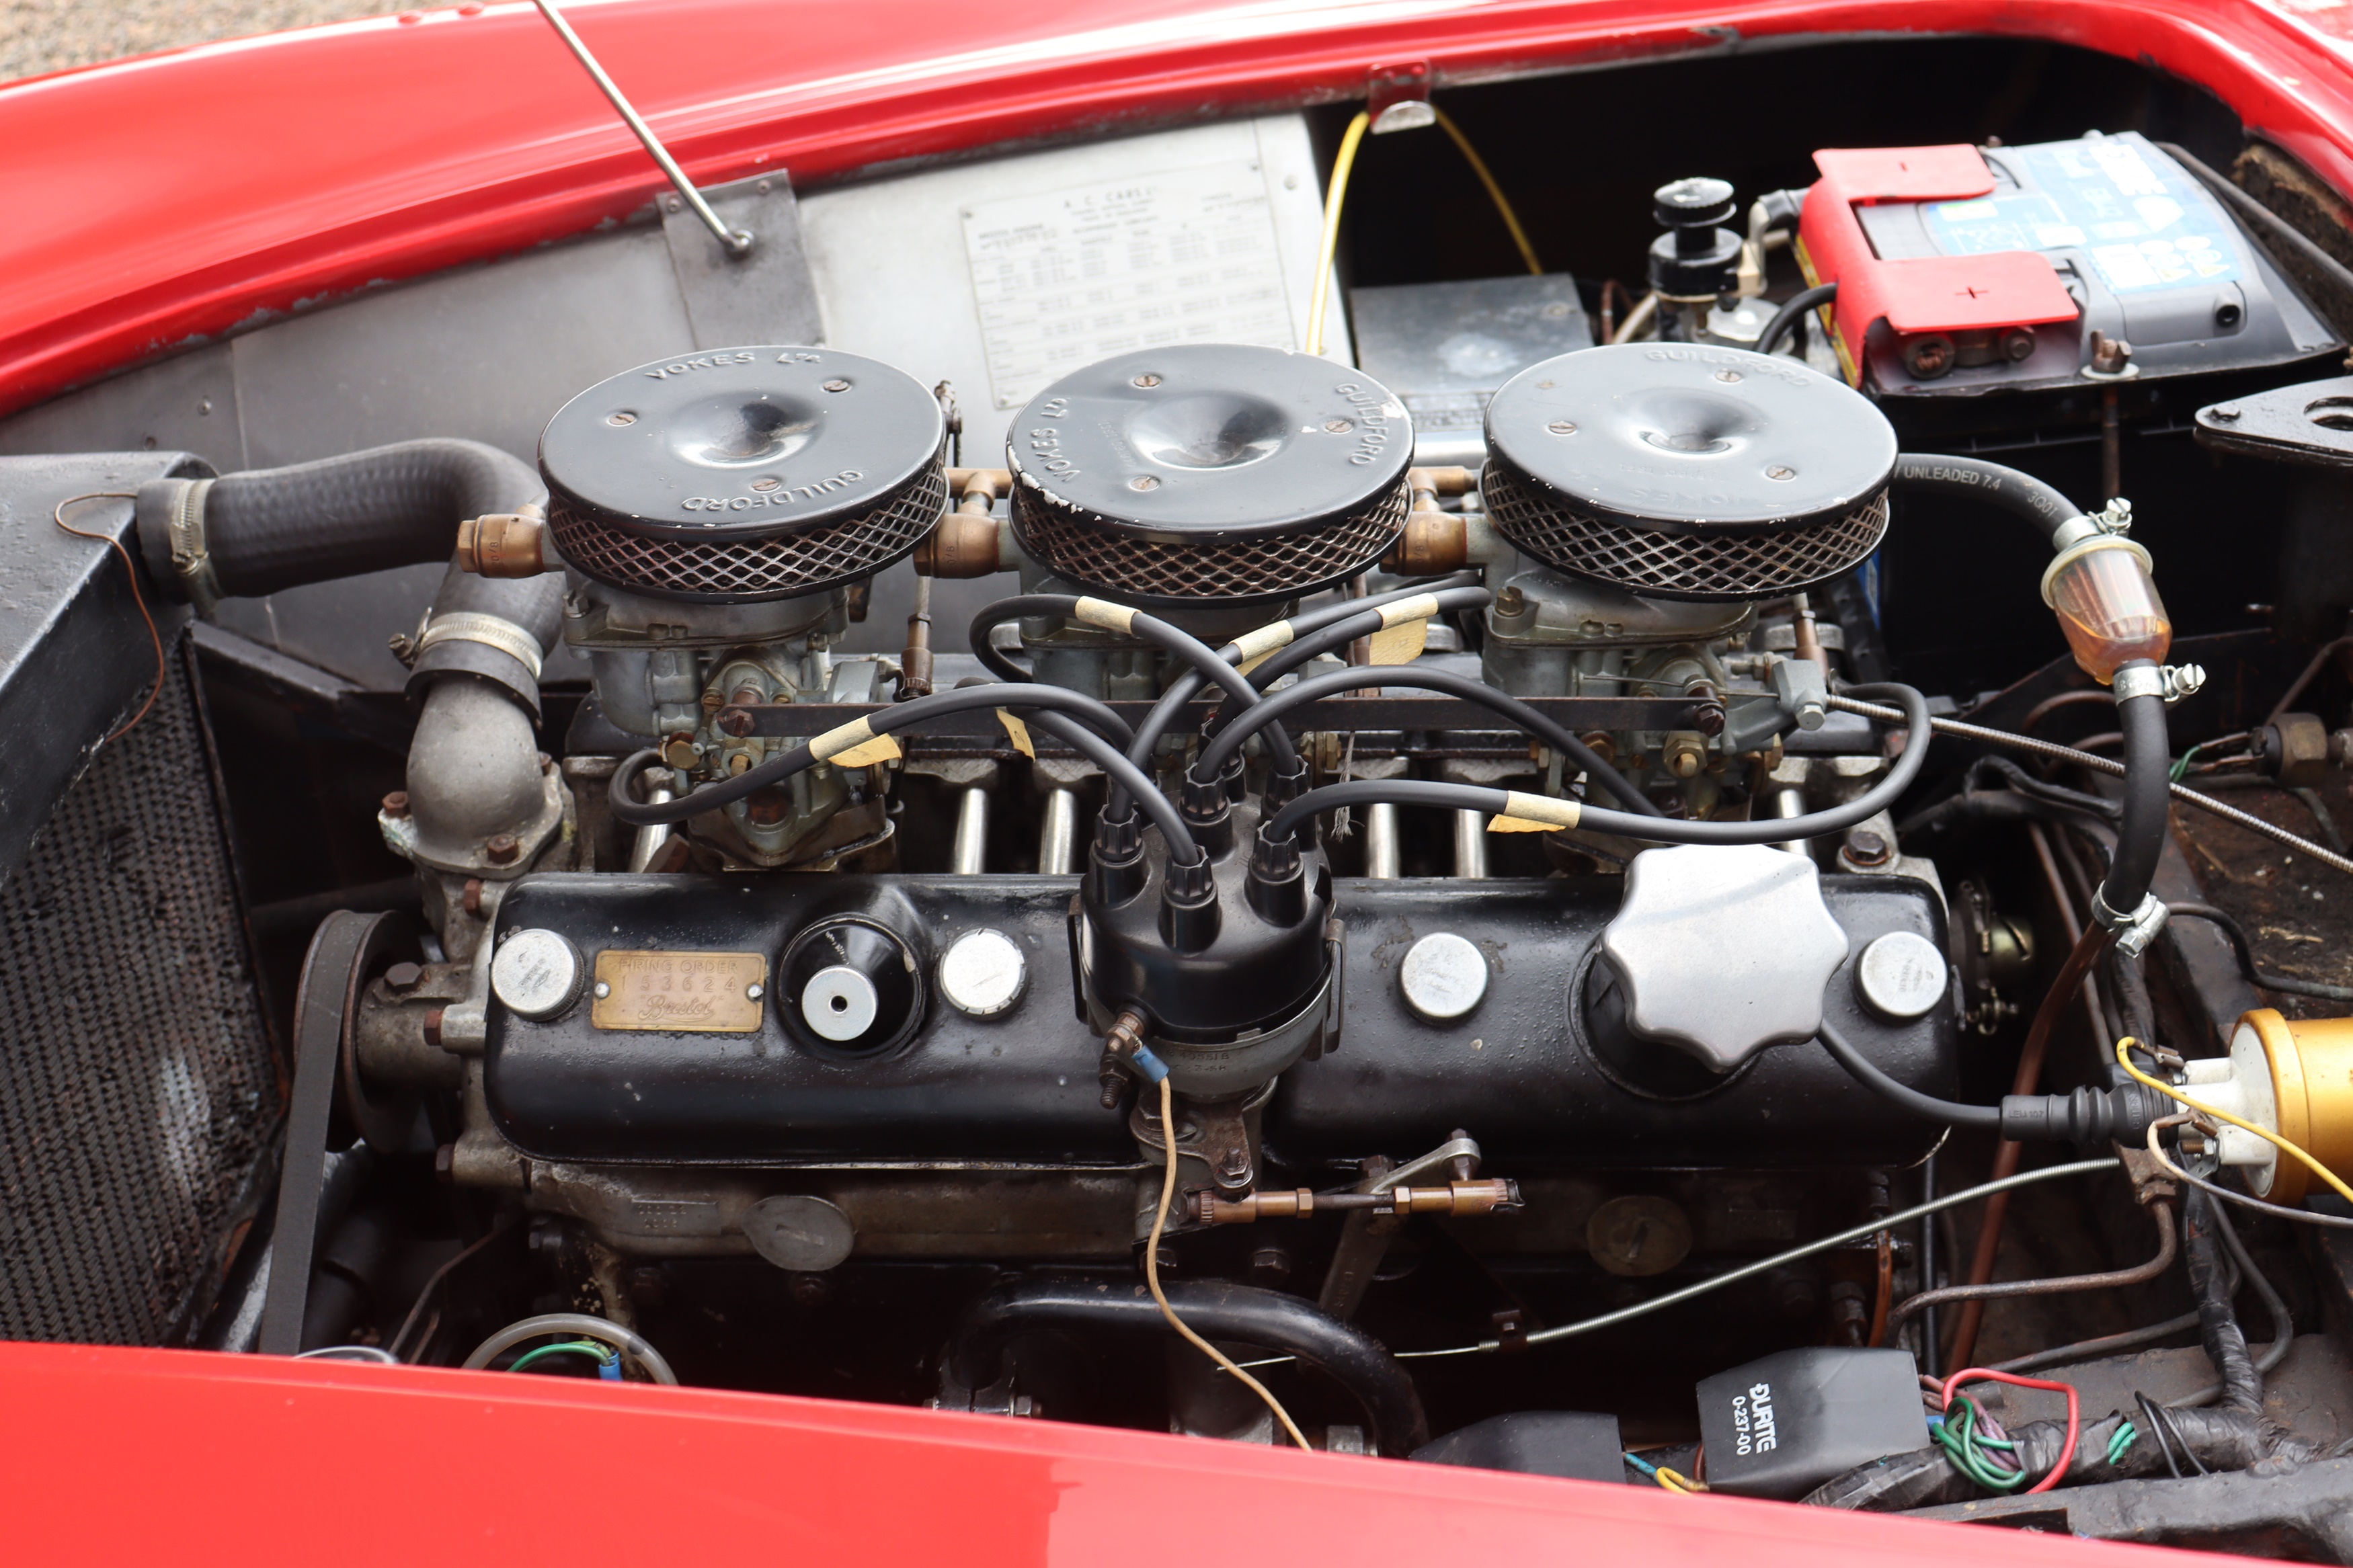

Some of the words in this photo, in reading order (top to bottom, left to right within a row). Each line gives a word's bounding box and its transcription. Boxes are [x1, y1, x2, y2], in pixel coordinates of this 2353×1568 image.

[643, 352, 756, 379] VOKES
[1646, 349, 1813, 386] GUILDFORD
[1334, 383, 1388, 465] GUILDFORD
[1030, 428, 1080, 482] VOKES
[682, 470, 864, 511] GUILDFORD
[1904, 466, 1980, 485] UNLEADED
[1983, 474, 2001, 491] 7.4
[2027, 491, 2059, 518] 3Q01
[619, 958, 673, 973] FIRING
[680, 959, 737, 973] ORDER
[622, 976, 627, 991] 1
[640, 977, 650, 991] 5
[662, 977, 672, 991] 3
[682, 977, 692, 993] 6
[704, 977, 714, 993] 2
[725, 977, 736, 993] 4
[1732, 1395, 1752, 1456] 0-237-00
[1749, 1383, 1777, 1454] DURITE
